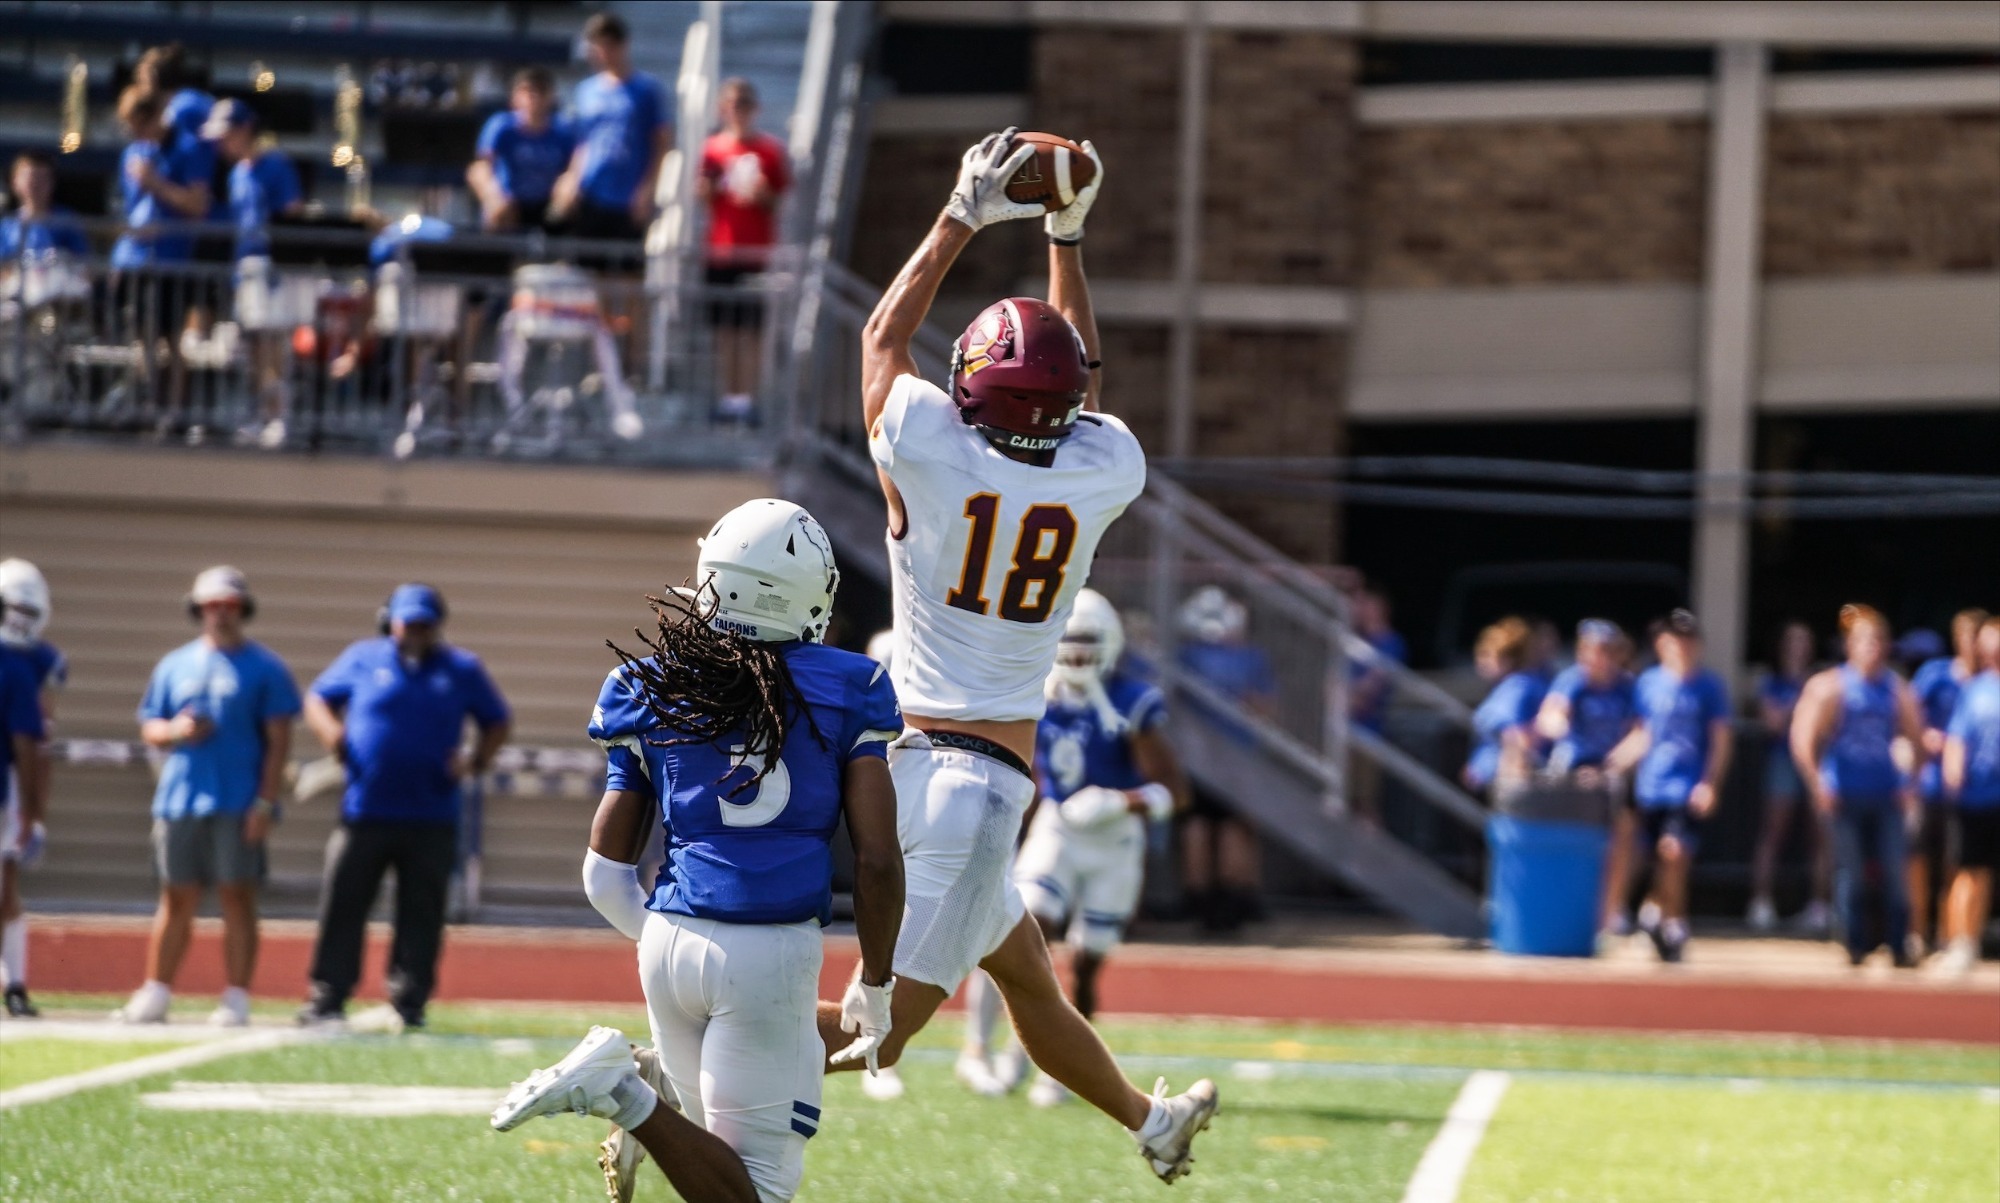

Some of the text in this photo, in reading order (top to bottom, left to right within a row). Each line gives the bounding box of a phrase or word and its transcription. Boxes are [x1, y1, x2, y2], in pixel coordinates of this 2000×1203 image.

[1010, 435, 1060, 450] CALVIN
[946, 491, 1079, 624] 18
[714, 617, 758, 637] FALCONS
